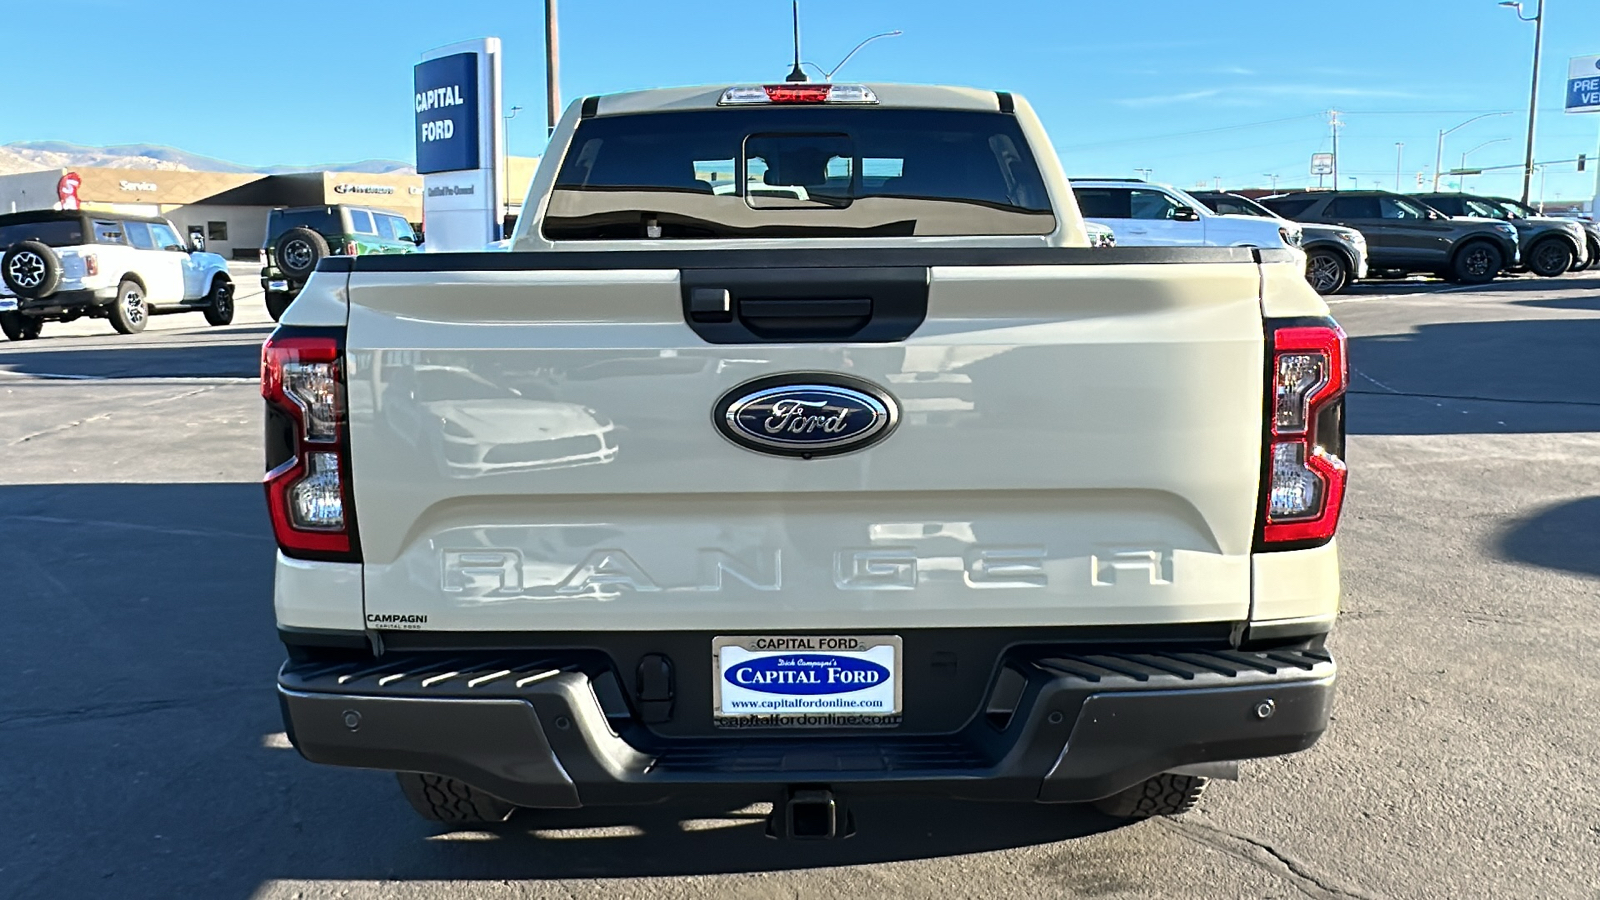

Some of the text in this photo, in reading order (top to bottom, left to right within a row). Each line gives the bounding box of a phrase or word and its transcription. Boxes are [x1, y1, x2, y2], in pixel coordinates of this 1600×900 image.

[415, 85, 464, 113] CAPITAL
[421, 119, 454, 143] FORD
[119, 180, 157, 191] Service
[764, 399, 848, 434] Ford
[440, 545, 1174, 593] RANGER
[366, 614, 428, 623] CAMPAGNI
[756, 638, 858, 650] CAPITAL FORD
[777, 658, 796, 667] Dick
[731, 698, 883, 710] www.capitalfordonline.com
[720, 713, 898, 728] capitalfordonline.com
